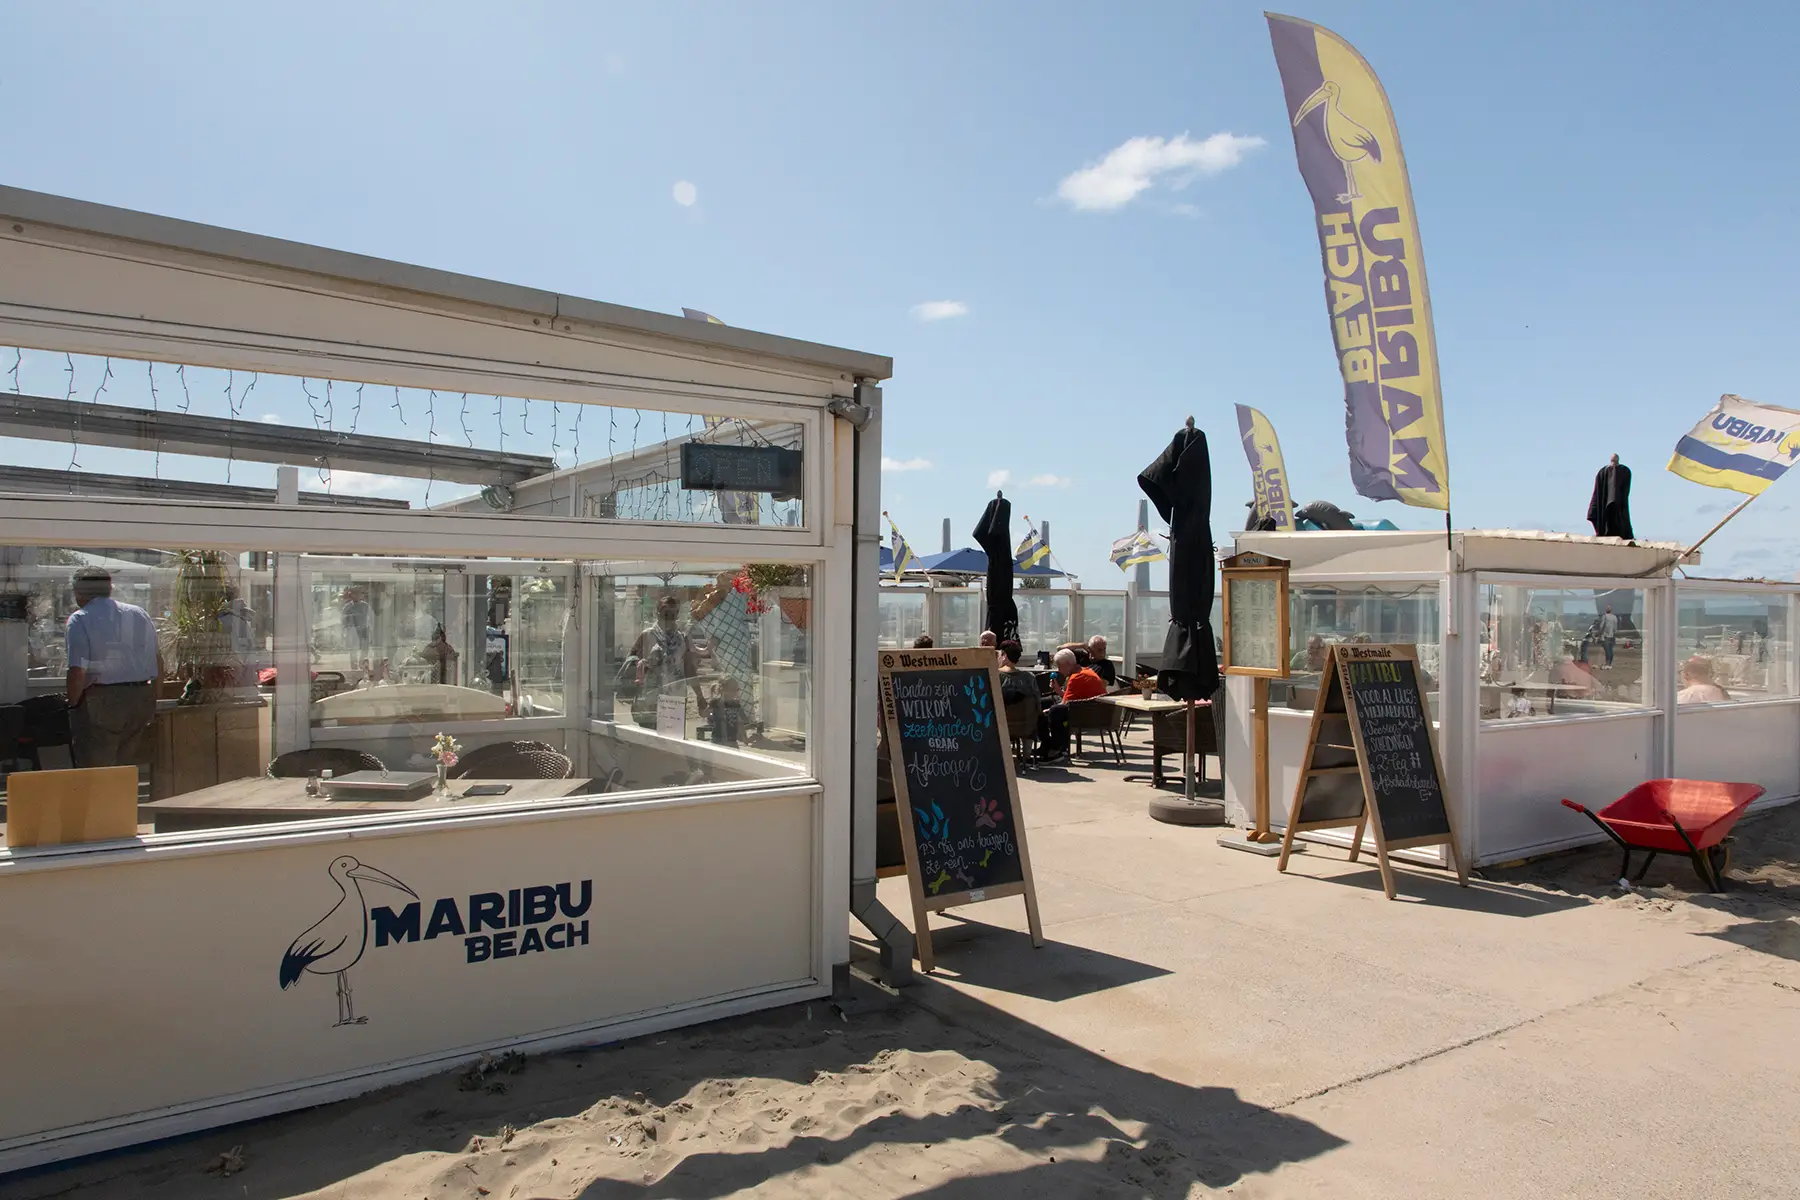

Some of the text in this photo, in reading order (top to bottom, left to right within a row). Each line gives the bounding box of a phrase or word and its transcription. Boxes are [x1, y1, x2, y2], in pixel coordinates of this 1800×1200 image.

[695, 455, 772, 483] OPEN
[899, 653, 958, 667] Westmalle
[1351, 647, 1392, 658] Westmalle
[882, 676, 895, 720] TRAPPIST
[893, 677, 932, 699] Honden
[928, 738, 959, 750] GRAAG
[957, 837, 975, 850] ons
[371, 879, 592, 948] MARIBU
[464, 920, 590, 964] BEACH
